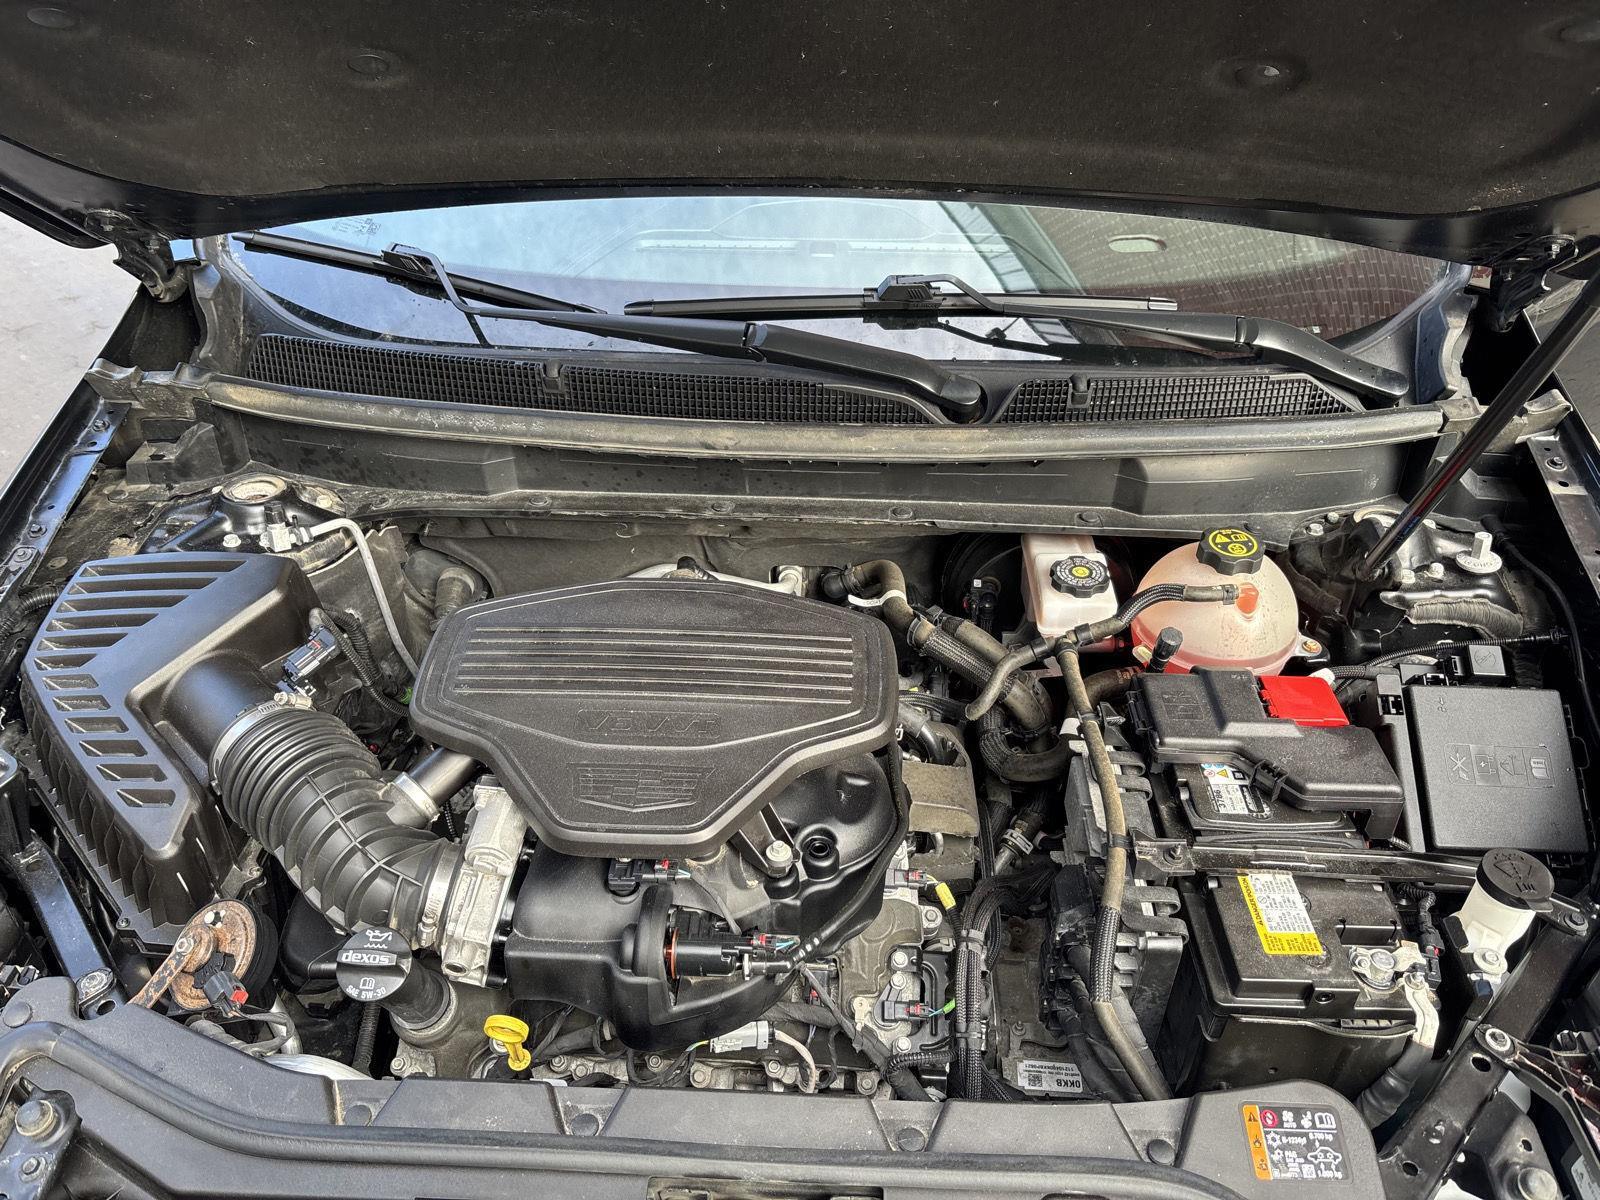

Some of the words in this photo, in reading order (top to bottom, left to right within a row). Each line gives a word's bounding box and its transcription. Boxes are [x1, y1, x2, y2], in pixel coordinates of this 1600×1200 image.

[1241, 877, 1253, 898] POISON
[341, 950, 390, 965] dexos
[346, 985, 360, 997] SAE
[361, 987, 386, 998] 5W-30
